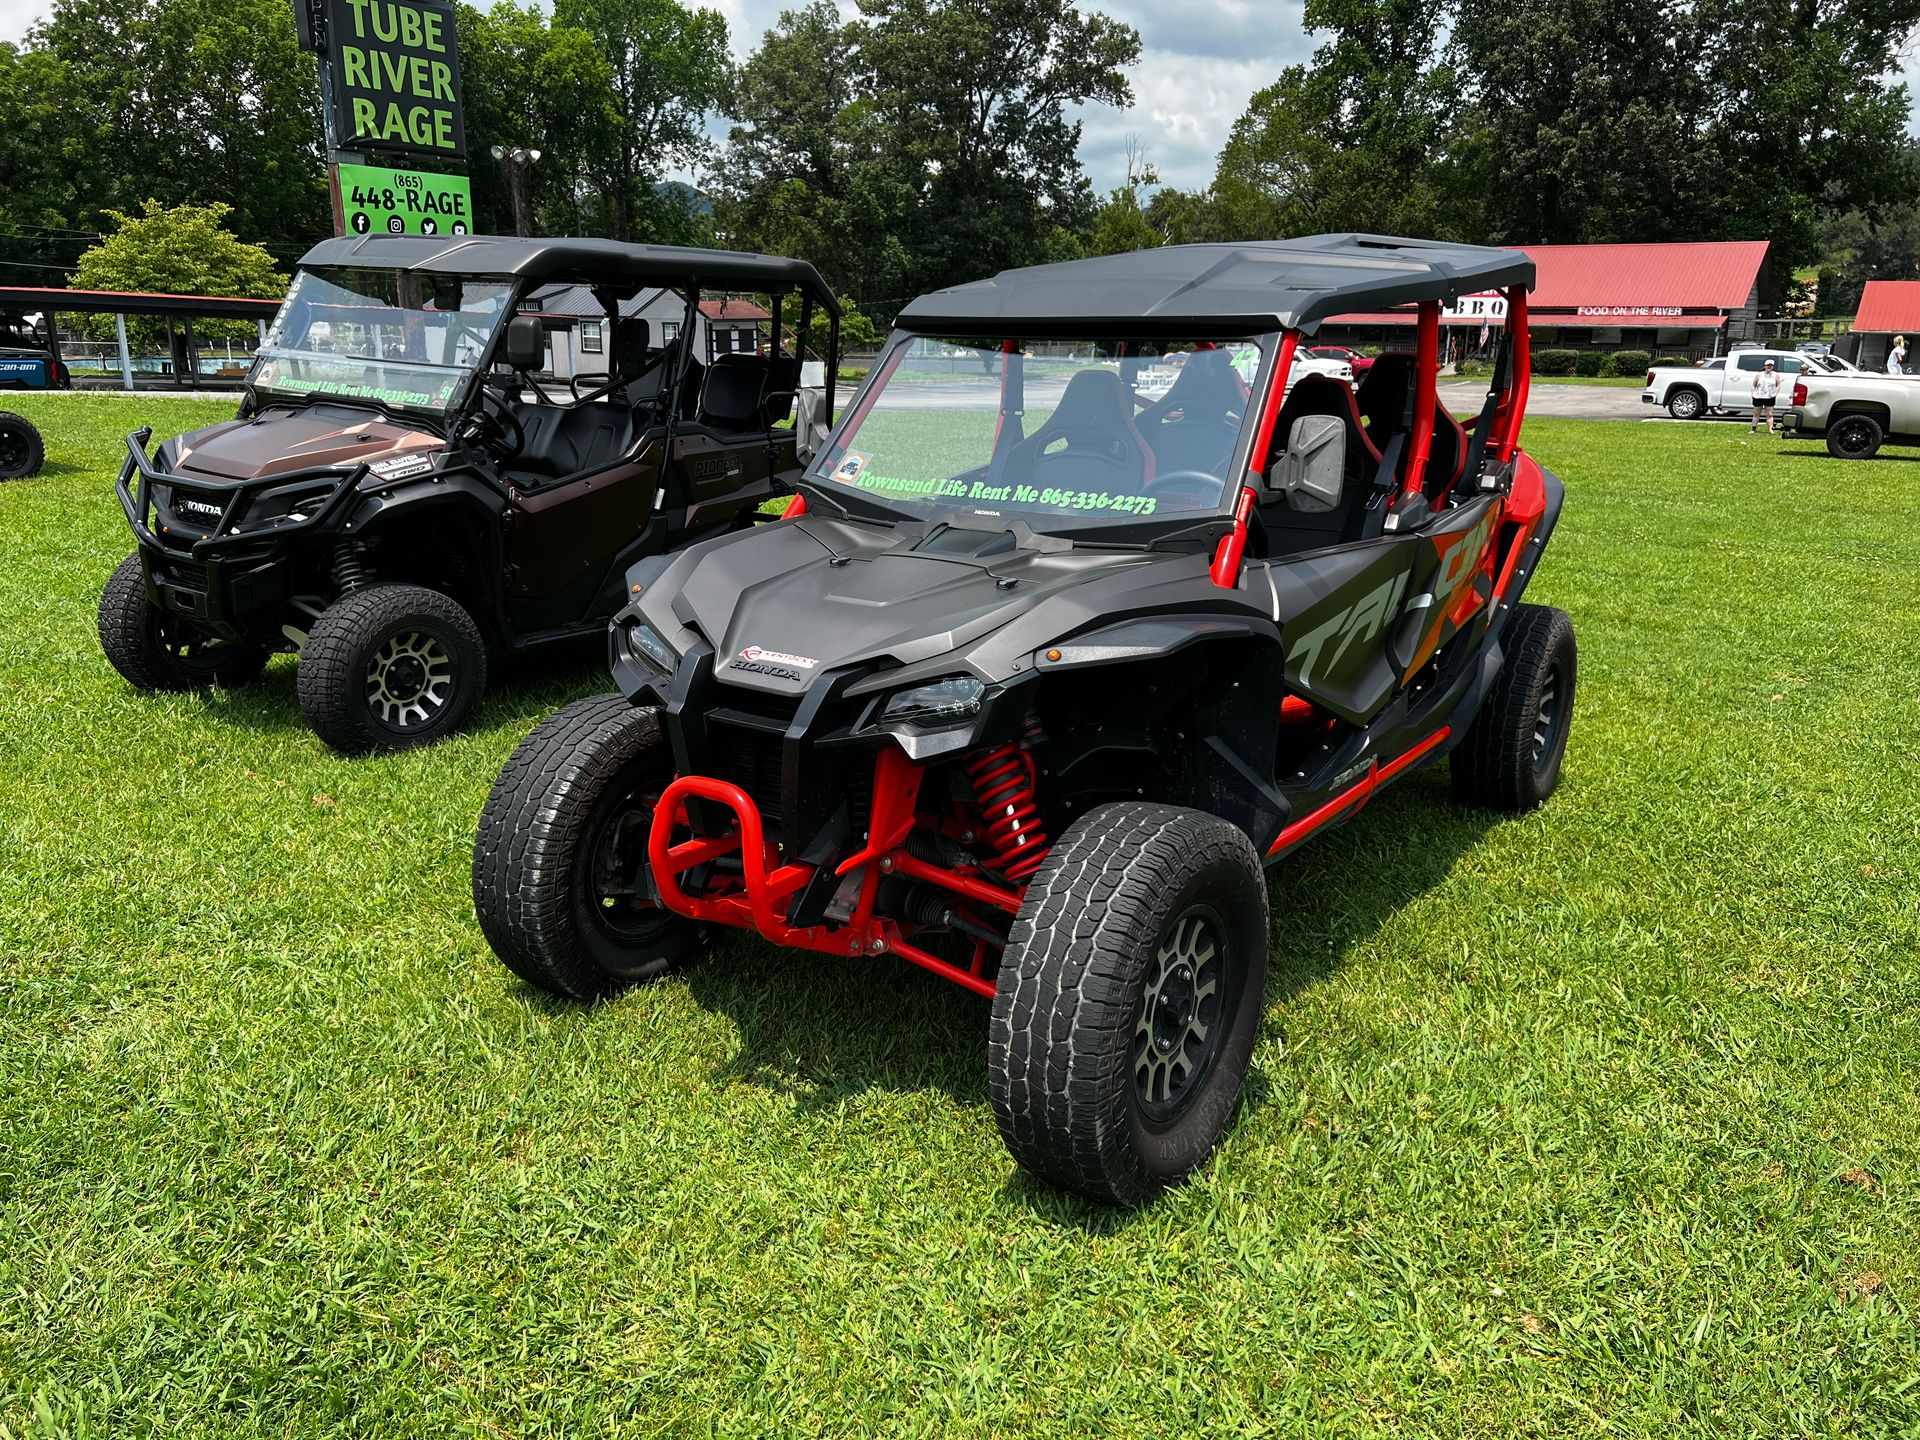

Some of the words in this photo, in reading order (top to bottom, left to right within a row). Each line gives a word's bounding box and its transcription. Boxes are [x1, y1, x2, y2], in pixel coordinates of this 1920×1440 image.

[346, 0, 446, 53] TUBE
[342, 46, 456, 102] RIVER
[353, 98, 456, 149] RAGE
[393, 173, 423, 191] (865)
[351, 185, 466, 217] 448-RAGE
[1577, 306, 1609, 316] FOOD
[1612, 306, 1627, 316] ON
[1631, 307, 1649, 316] THE
[1652, 307, 1683, 316] RIVER
[278, 376, 321, 391] Townsend
[320, 381, 338, 394] Life
[857, 470, 937, 494] Townsend
[935, 478, 968, 497] Life
[967, 480, 1011, 501] Rent
[1012, 484, 1039, 503] Me
[1039, 487, 1157, 515] 865-336-2273
[974, 509, 1001, 517] HONDA
[729, 660, 801, 682] HONDA
